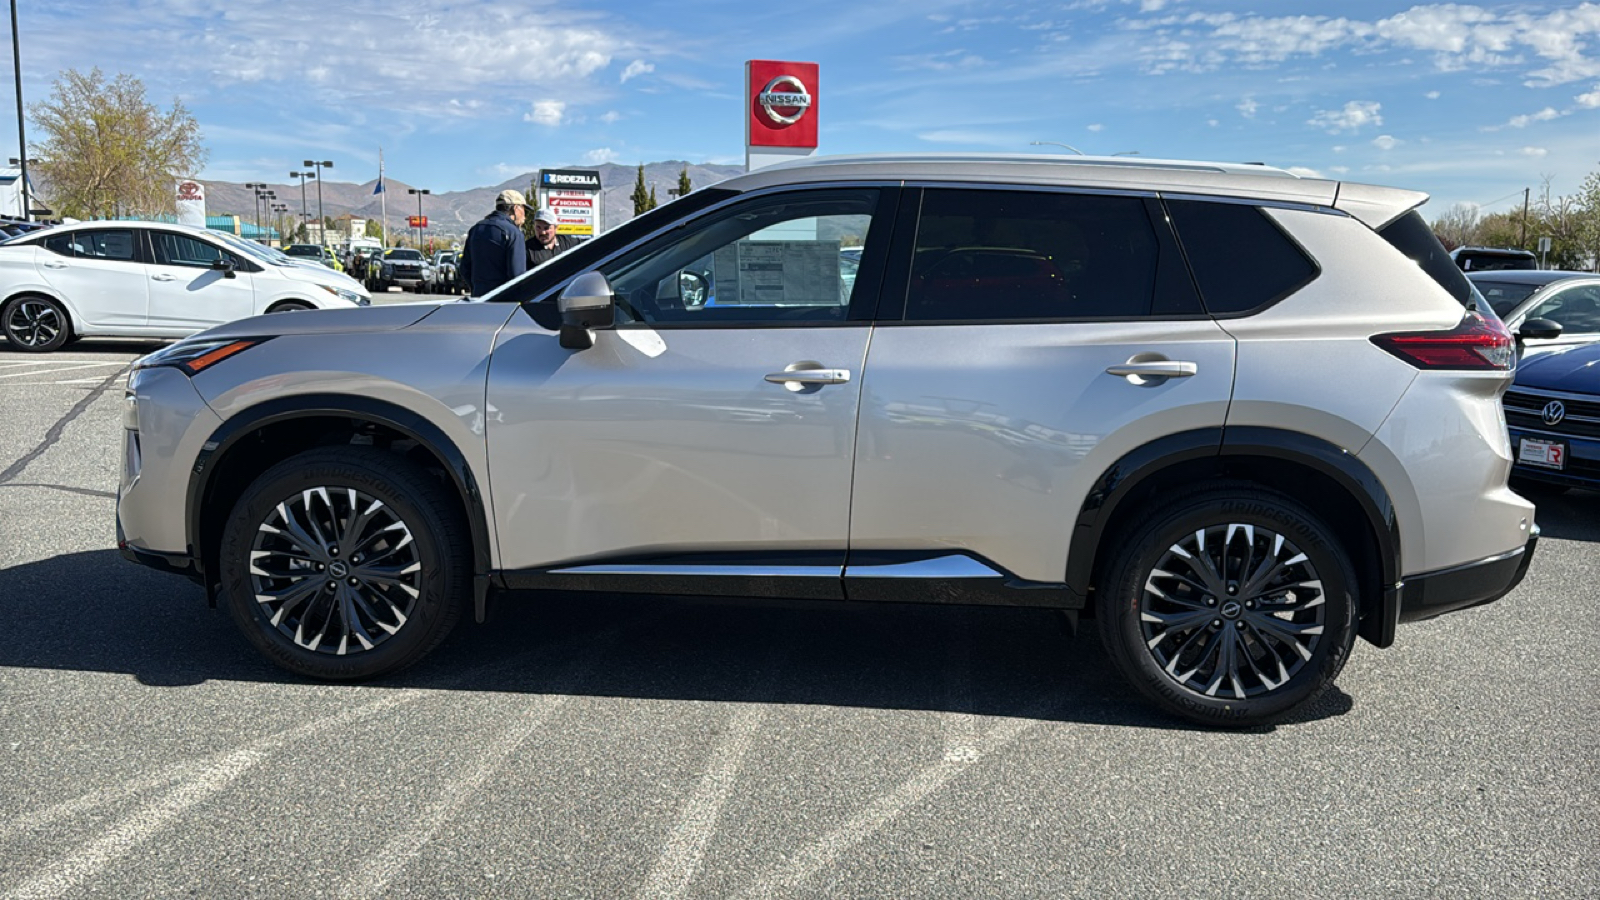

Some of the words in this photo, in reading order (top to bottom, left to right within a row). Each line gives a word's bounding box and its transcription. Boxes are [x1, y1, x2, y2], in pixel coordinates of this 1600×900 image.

[765, 95, 807, 104] NISSAN
[557, 174, 598, 184] RIDEZILLA
[1220, 501, 1325, 546] BRIDGESTONE
